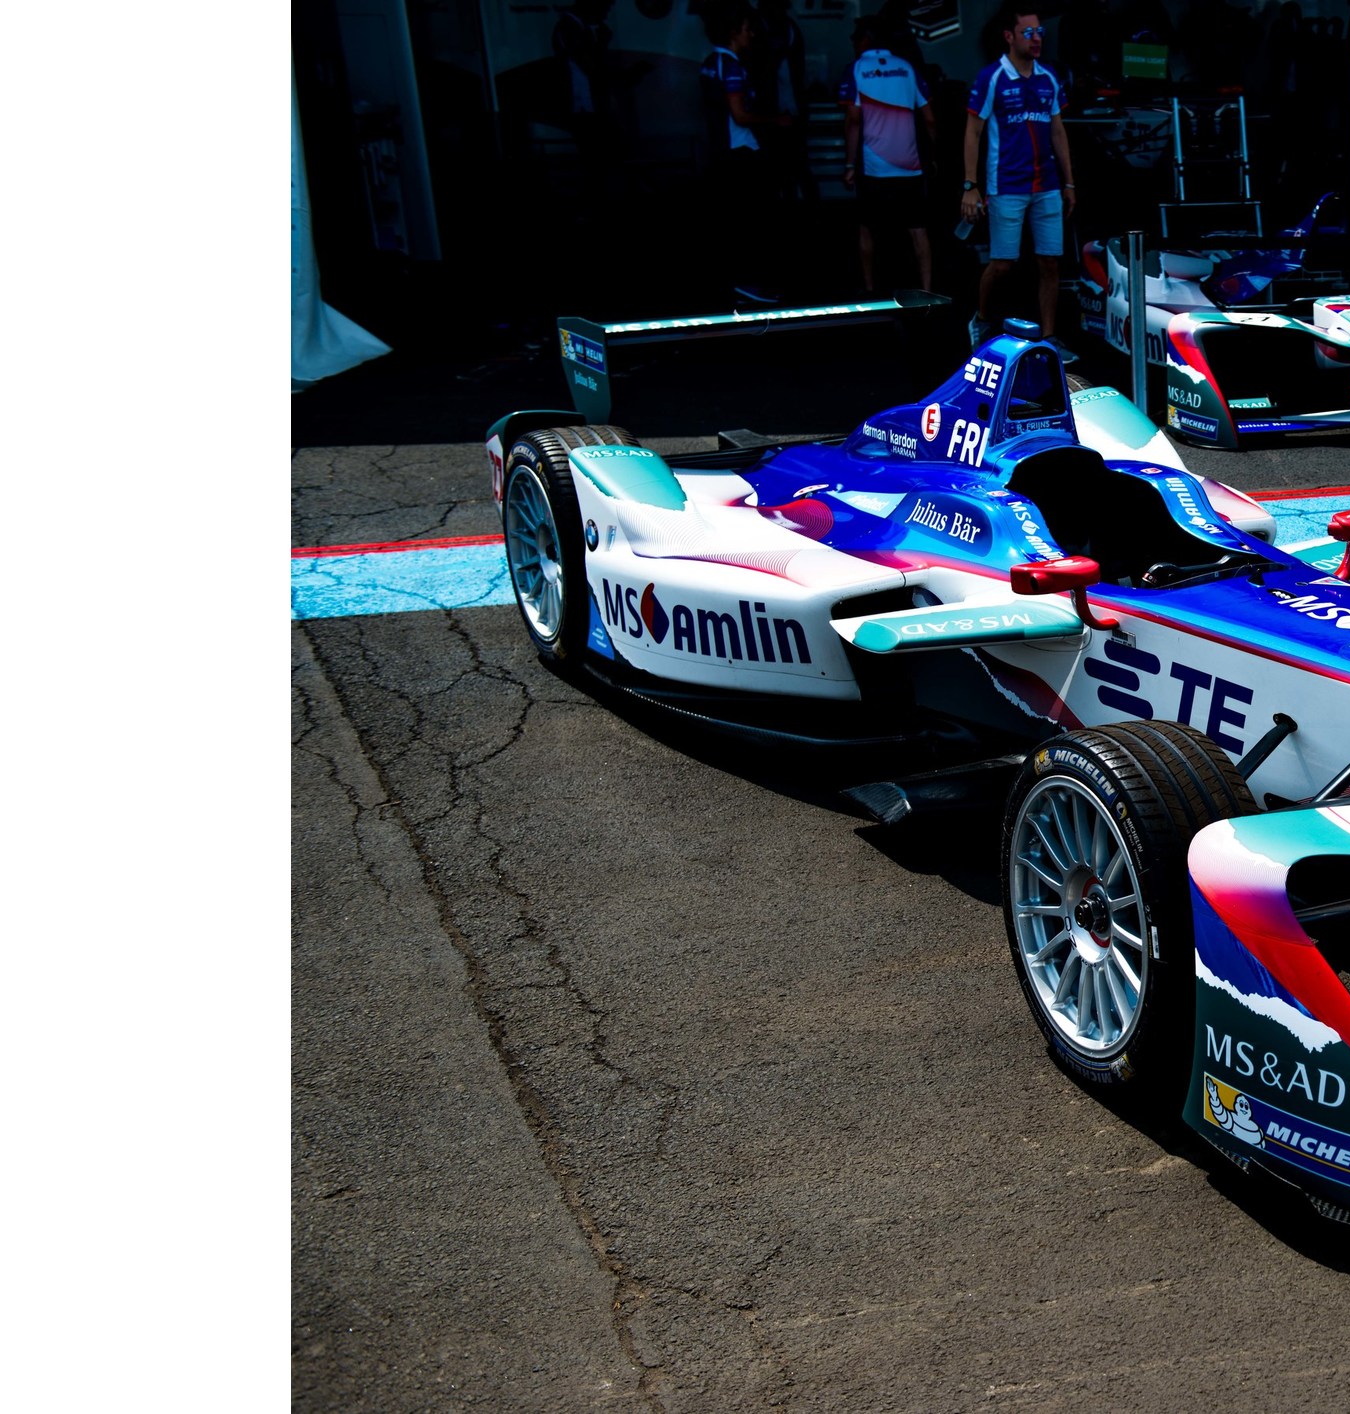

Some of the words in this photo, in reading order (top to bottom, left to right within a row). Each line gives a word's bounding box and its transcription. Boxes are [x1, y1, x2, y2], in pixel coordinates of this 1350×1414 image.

[575, 342, 603, 362] MIHELIN
[980, 360, 1002, 389] TE
[926, 409, 936, 435] E
[1180, 415, 1217, 433] MICHELIN
[584, 449, 654, 459] MS&AD
[947, 418, 990, 468] FRI
[905, 498, 948, 532] Julius
[948, 512, 981, 544] Bär
[1007, 501, 1032, 521] MS
[1199, 523, 1223, 534] MS
[602, 578, 643, 638] MS
[672, 600, 812, 664] Amlin
[901, 613, 1034, 635] MS&AD
[1170, 661, 1254, 756] TE
[1054, 749, 1116, 797] MICHELIN
[1205, 1024, 1346, 1108] MS&AD
